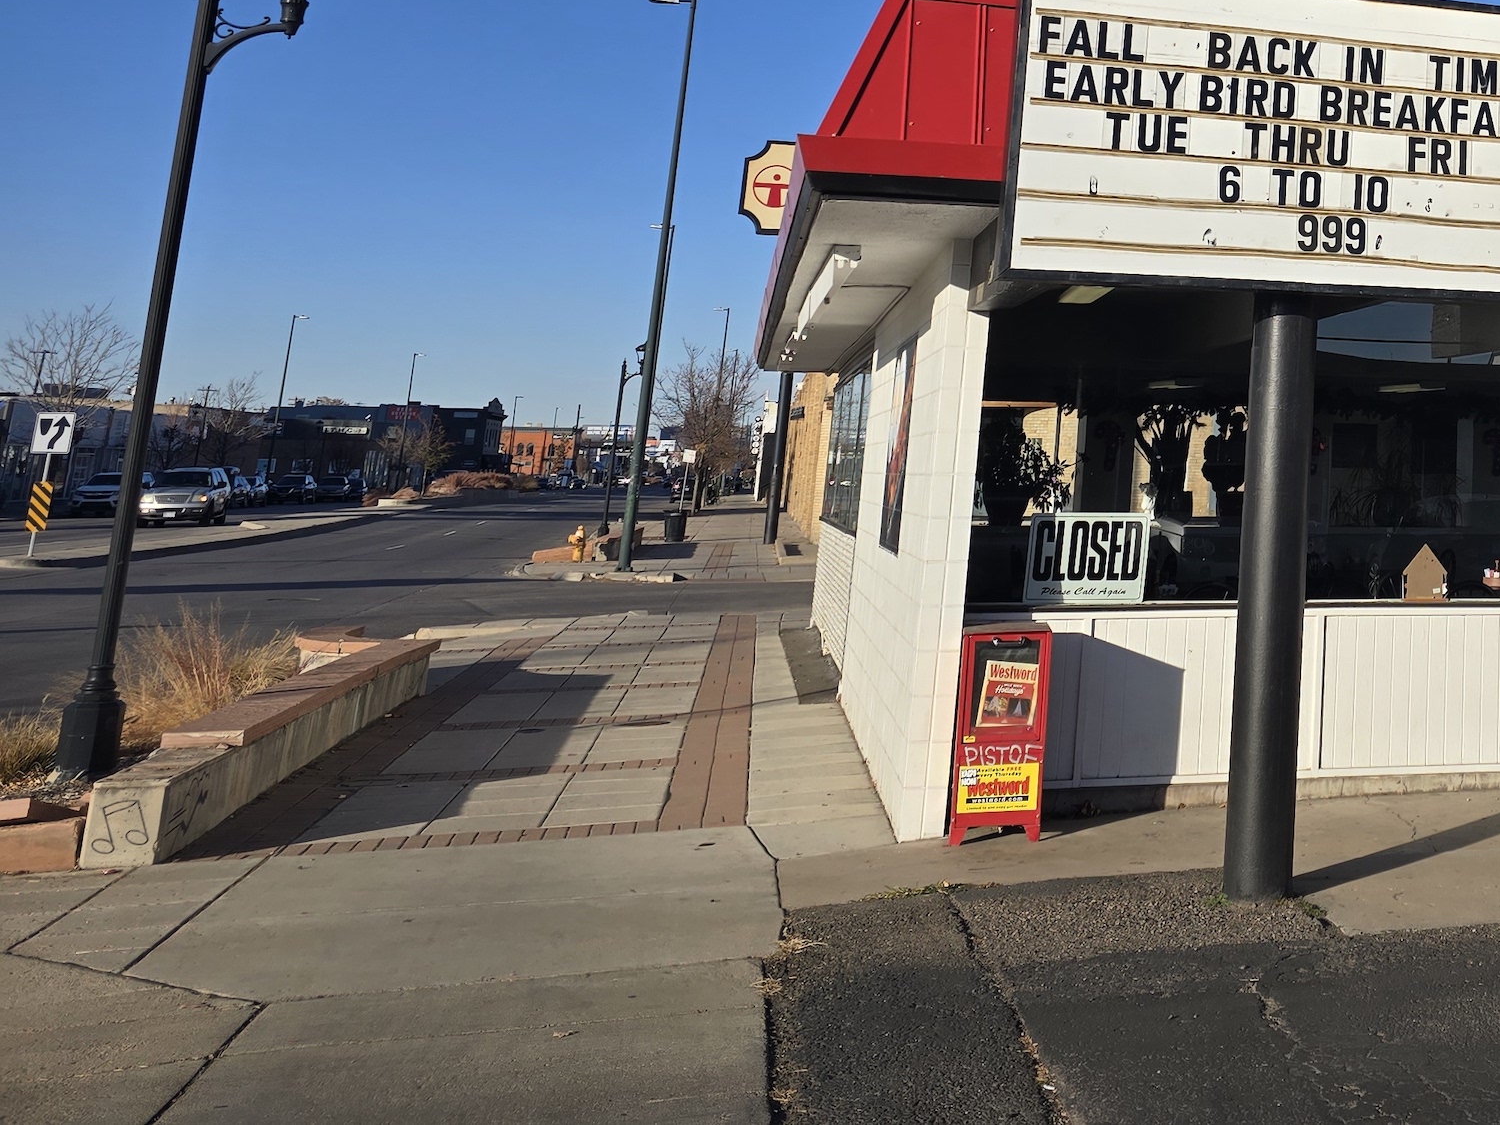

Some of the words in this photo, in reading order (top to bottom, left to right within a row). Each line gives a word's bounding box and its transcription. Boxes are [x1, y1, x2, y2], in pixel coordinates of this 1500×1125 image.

[1040, 16, 1144, 63] FALL
[1208, 32, 1317, 78] BACK
[1346, 46, 1384, 85] IN
[1045, 61, 1184, 109] EARLY
[1201, 75, 1295, 119] BIRD
[1106, 112, 1188, 154] TUE
[1244, 123, 1350, 167] THRU
[1408, 137, 1467, 175] FRI
[1219, 166, 1241, 203] 6
[1272, 168, 1322, 208] TO
[1298, 215, 1367, 255] 999
[1032, 520, 1143, 581] CLOSED
[1041, 586, 1071, 596] Please
[1074, 586, 1096, 596] Call
[1098, 586, 1127, 597] Again
[990, 663, 1038, 681] Westword
[967, 776, 1030, 797] Westword
